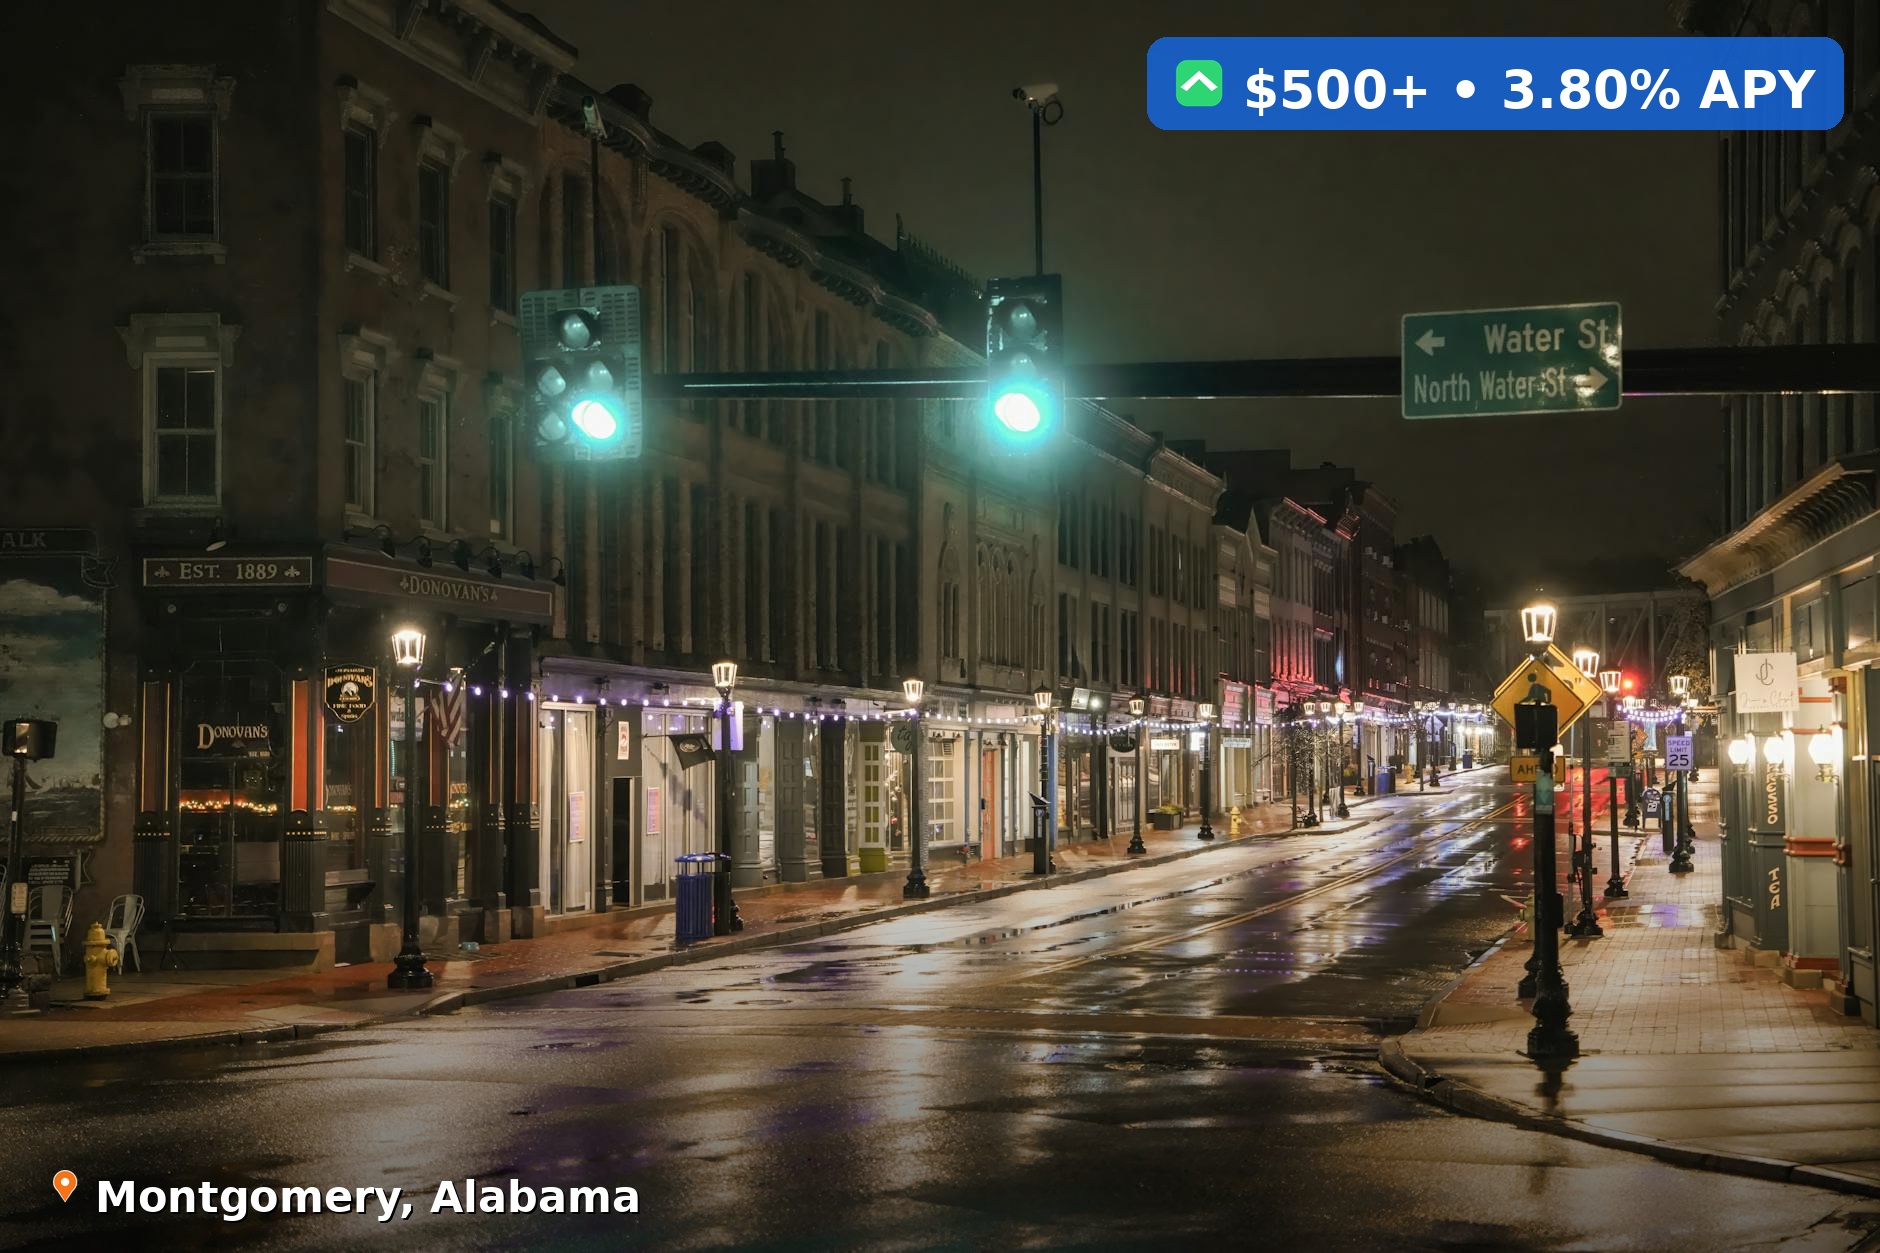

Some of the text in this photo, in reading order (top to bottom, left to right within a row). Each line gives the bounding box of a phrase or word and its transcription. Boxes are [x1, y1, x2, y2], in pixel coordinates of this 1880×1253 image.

[1484, 318, 1608, 354] Water St
[1414, 366, 1567, 404] North Water St
[179, 563, 278, 580] EST. 1889
[409, 575, 490, 602] DONOVAN'S
[197, 723, 269, 750] DONOVAN'S
[1668, 754, 1690, 767] 25
[1768, 866, 1781, 911] TEA
